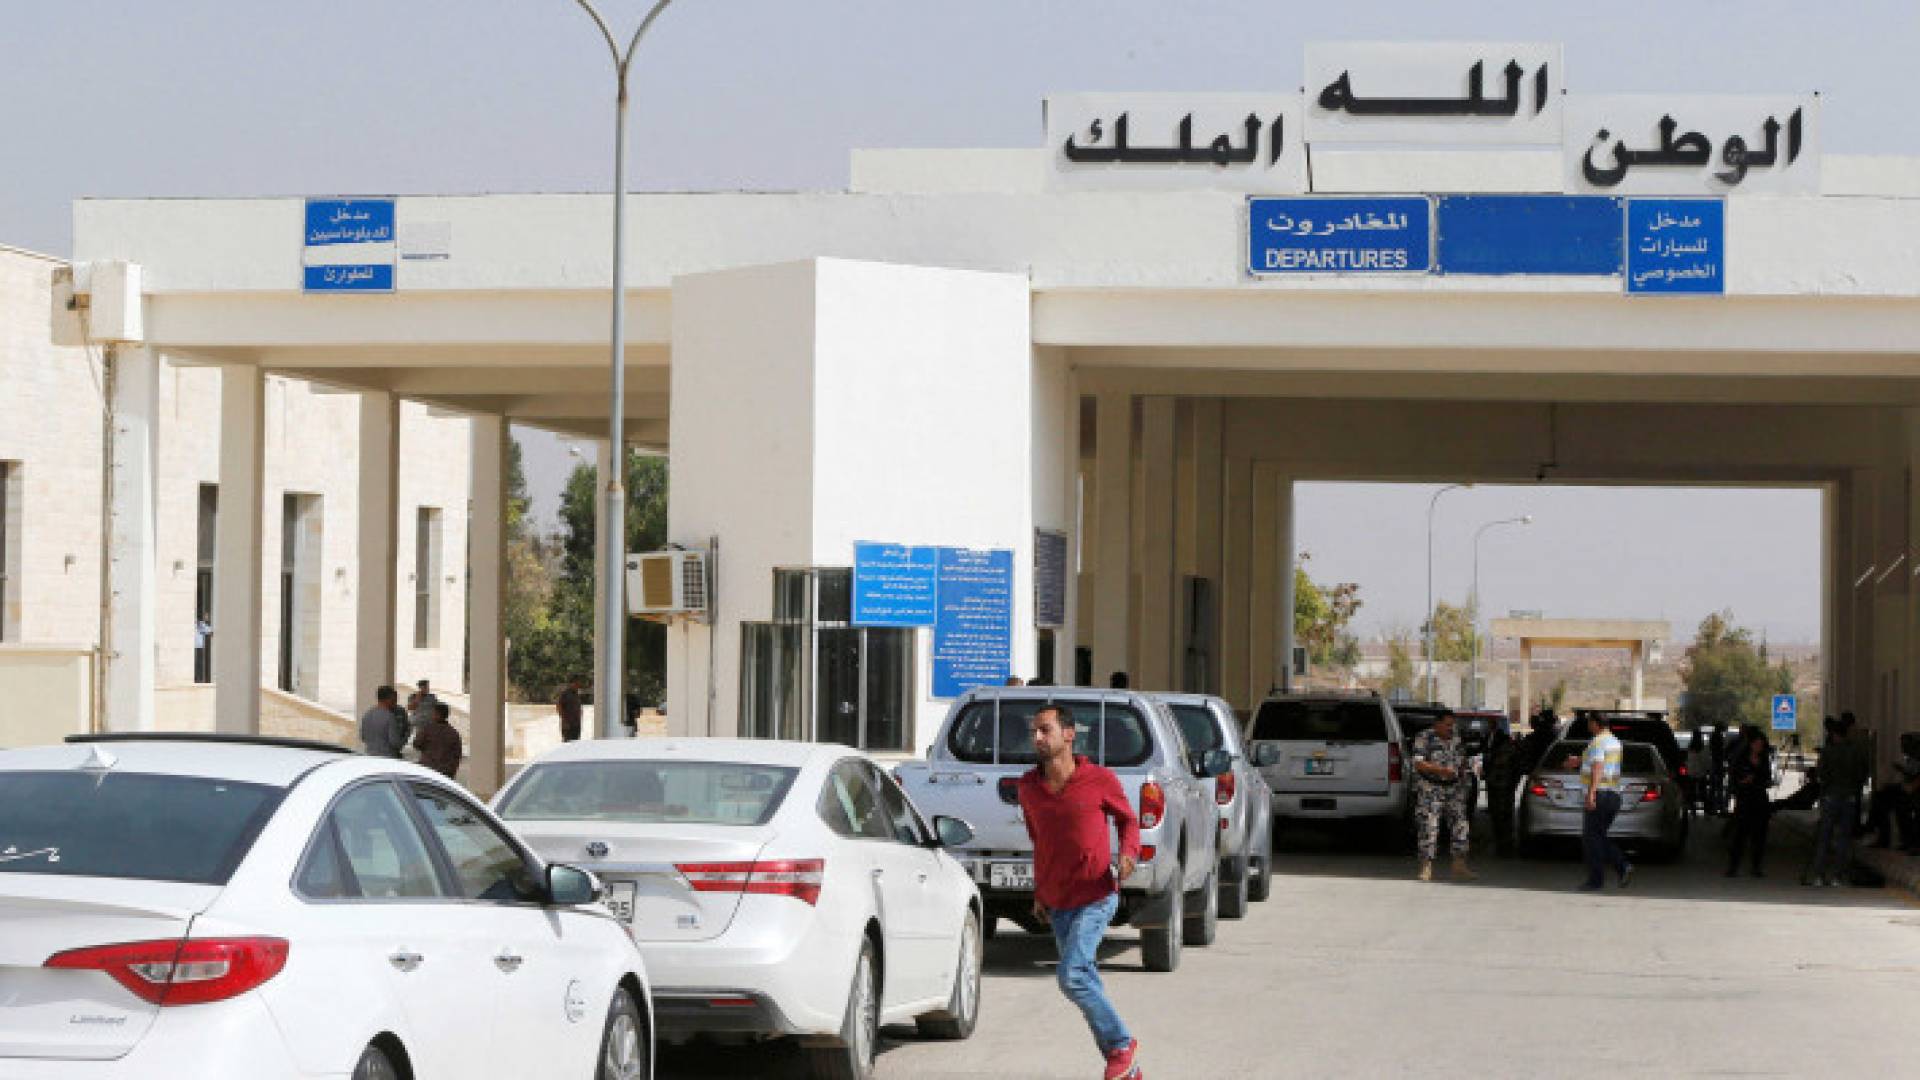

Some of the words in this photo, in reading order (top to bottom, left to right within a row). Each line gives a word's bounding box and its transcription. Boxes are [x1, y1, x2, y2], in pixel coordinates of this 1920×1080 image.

[1318, 58, 1548, 117] الله
[1064, 110, 1279, 168] الملك
[1582, 105, 1802, 187] الوطن
[1266, 203, 1408, 236] المغادرون
[1650, 210, 1702, 231] مدخل
[1265, 248, 1408, 268] DEPARTURES
[1639, 237, 1708, 257] للسيارات
[1632, 264, 1716, 288] الخصوصي
